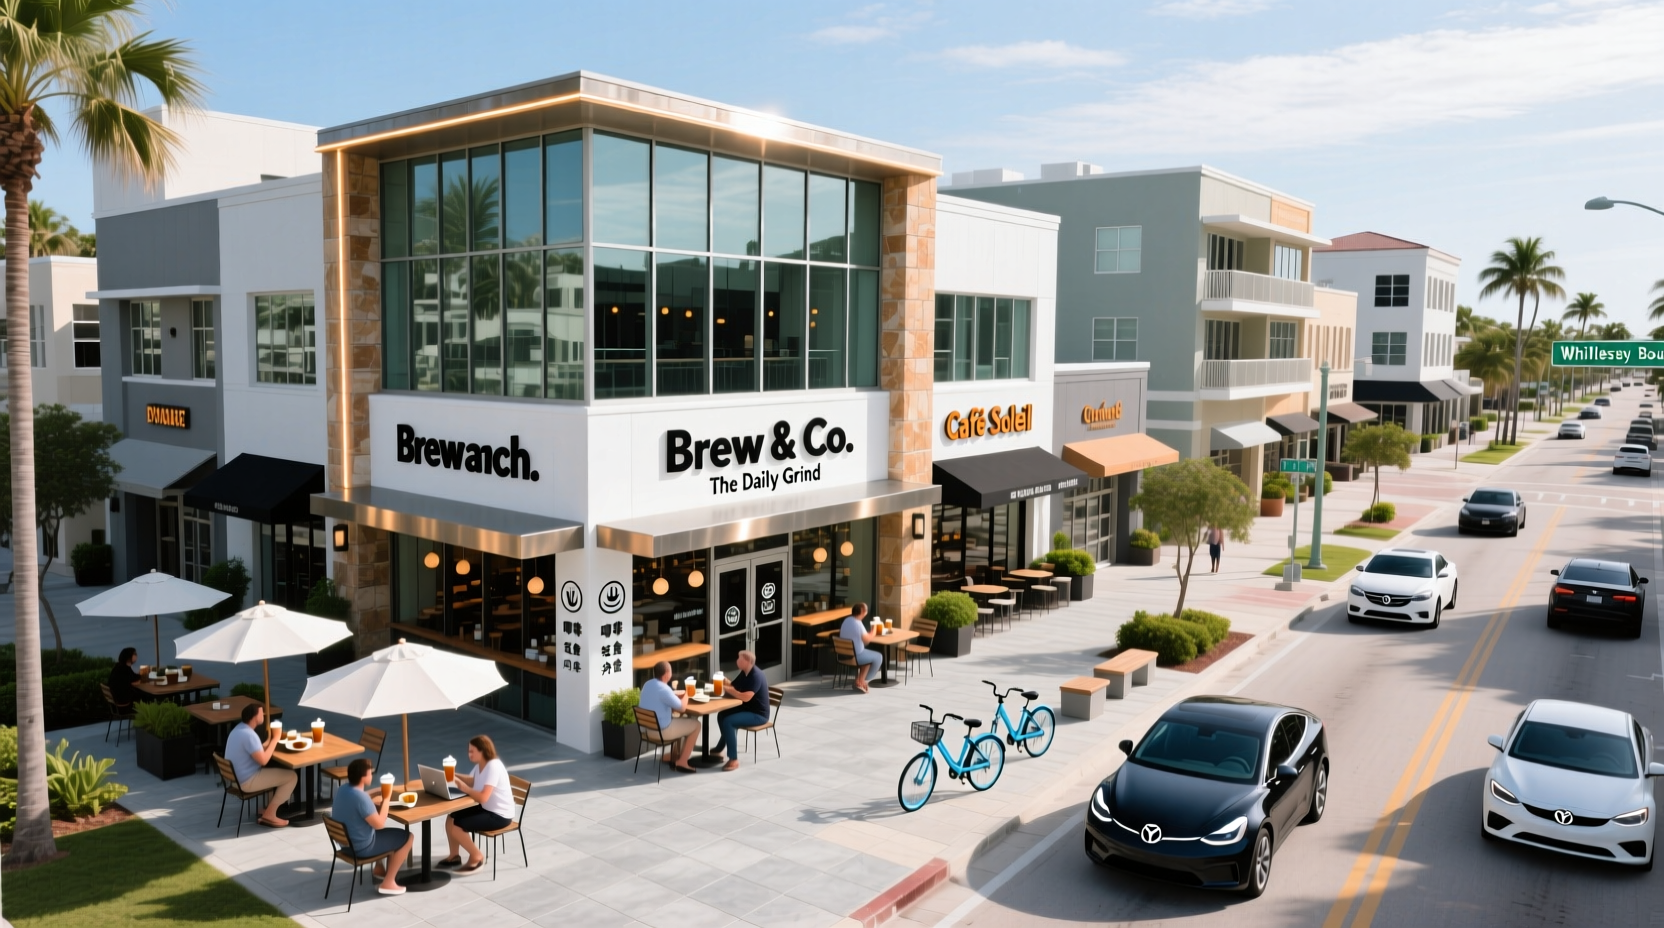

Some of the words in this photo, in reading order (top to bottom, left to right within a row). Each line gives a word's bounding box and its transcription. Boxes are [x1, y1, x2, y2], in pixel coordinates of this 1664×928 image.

[944, 406, 986, 441] Café
[987, 403, 1033, 436] Soleil
[666, 429, 765, 473] Brew
[770, 420, 796, 461] &
[803, 416, 854, 457] Co.
[709, 475, 738, 495] The
[742, 470, 779, 491] Daily
[782, 462, 821, 485] Grind
